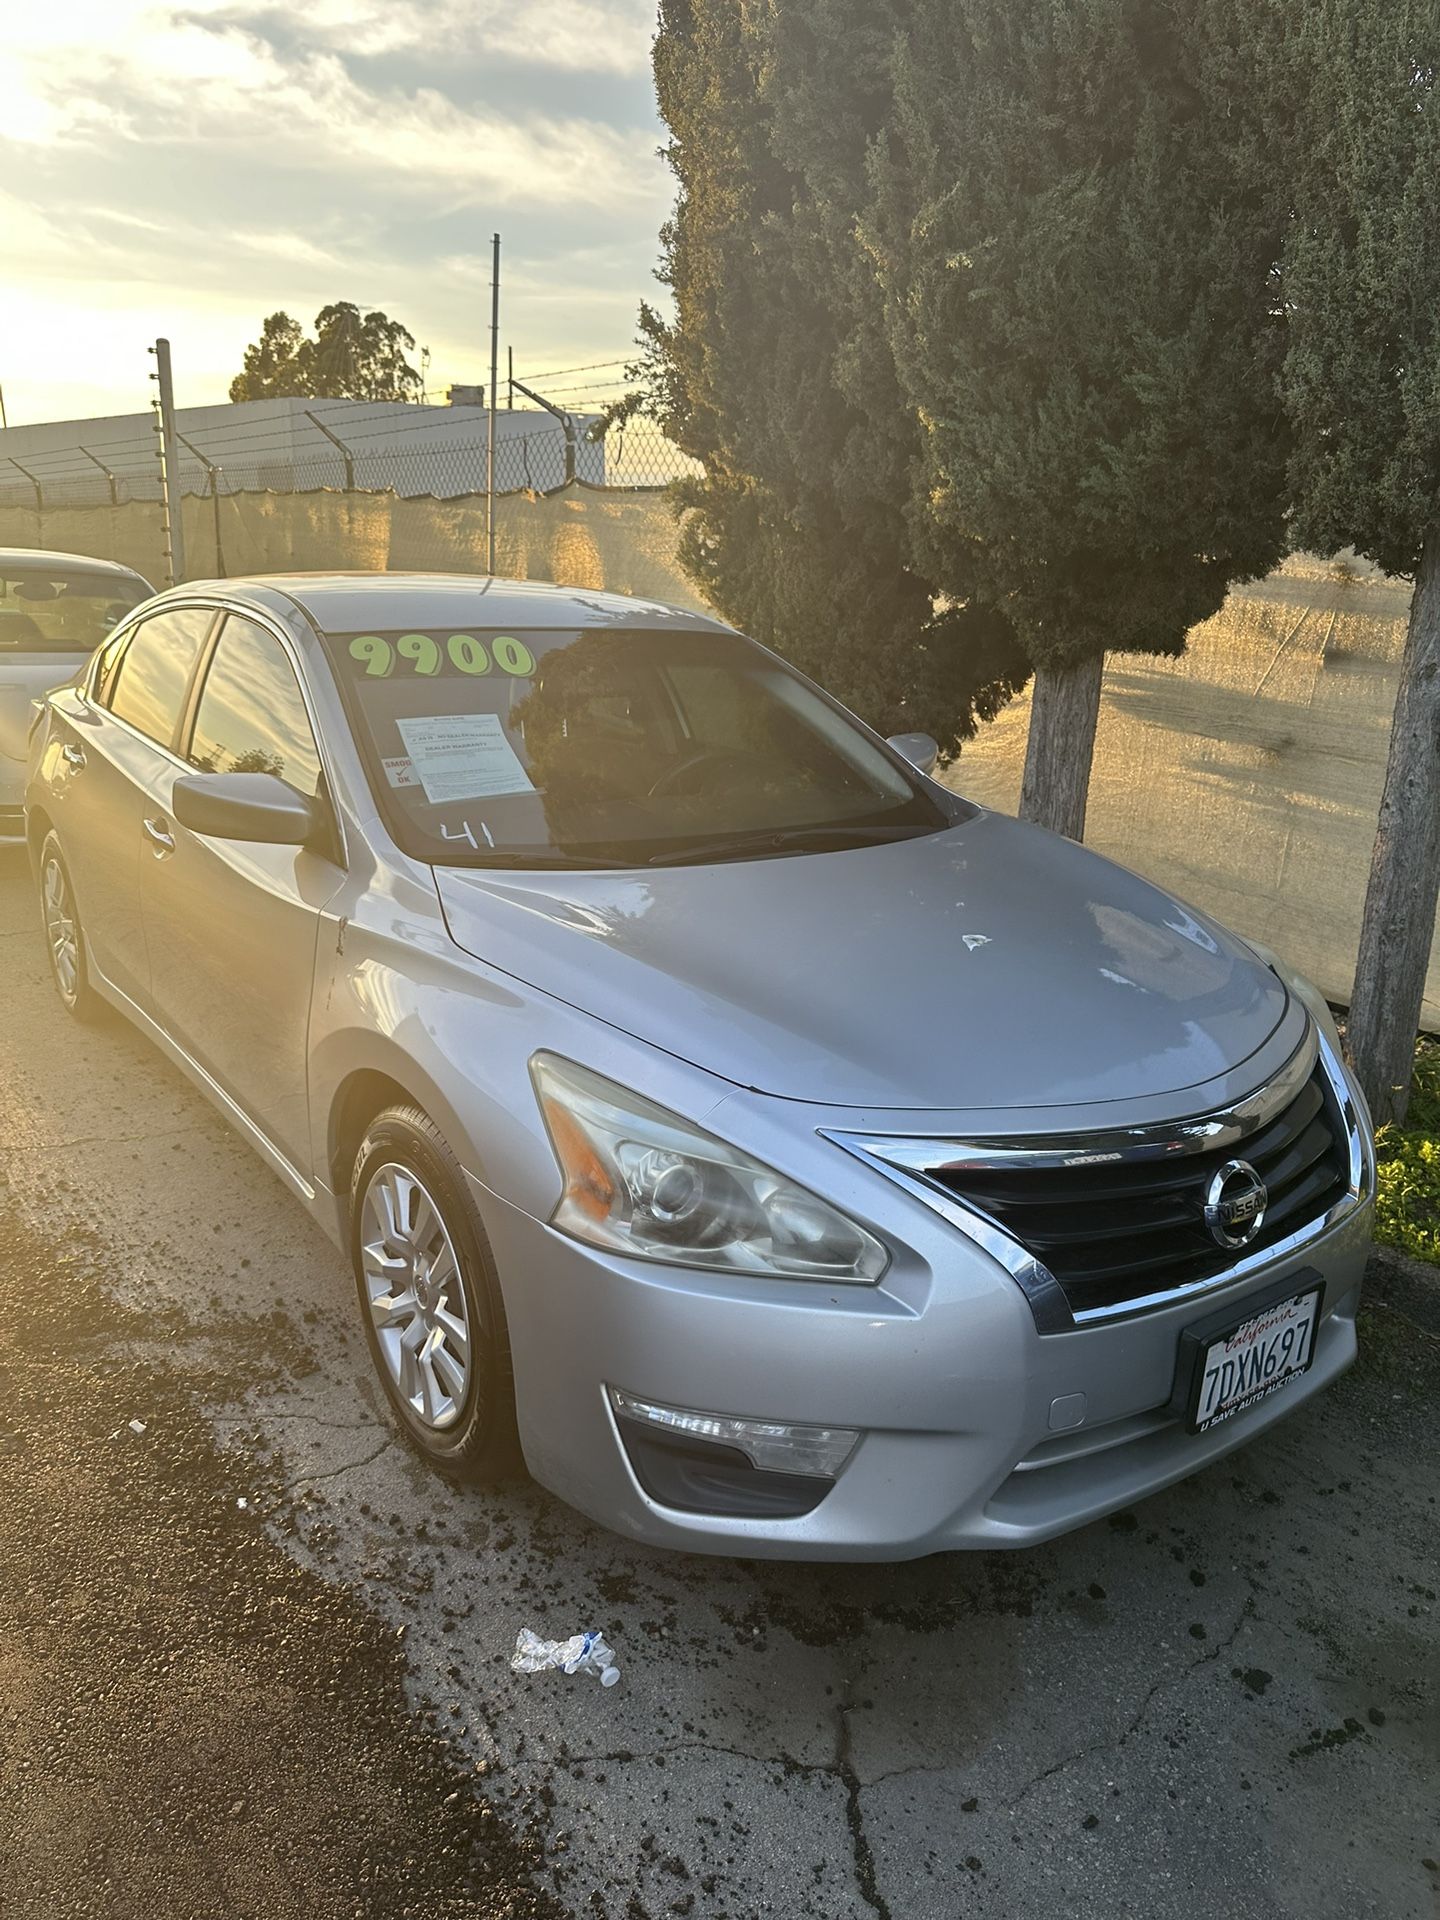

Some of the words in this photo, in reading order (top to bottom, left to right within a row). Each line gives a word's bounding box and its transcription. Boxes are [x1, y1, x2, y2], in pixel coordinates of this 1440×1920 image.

[349, 634, 537, 677] 9900
[397, 776, 411, 784] OK
[440, 821, 494, 848] 41
[1225, 1308, 1298, 1353] California
[1205, 1318, 1310, 1412] 7DXN697
[1200, 1421, 1210, 1432] U
[1210, 1405, 1239, 1427] SAVE
[1238, 1391, 1264, 1412] AUTO
[1265, 1367, 1306, 1397] AUCTION
